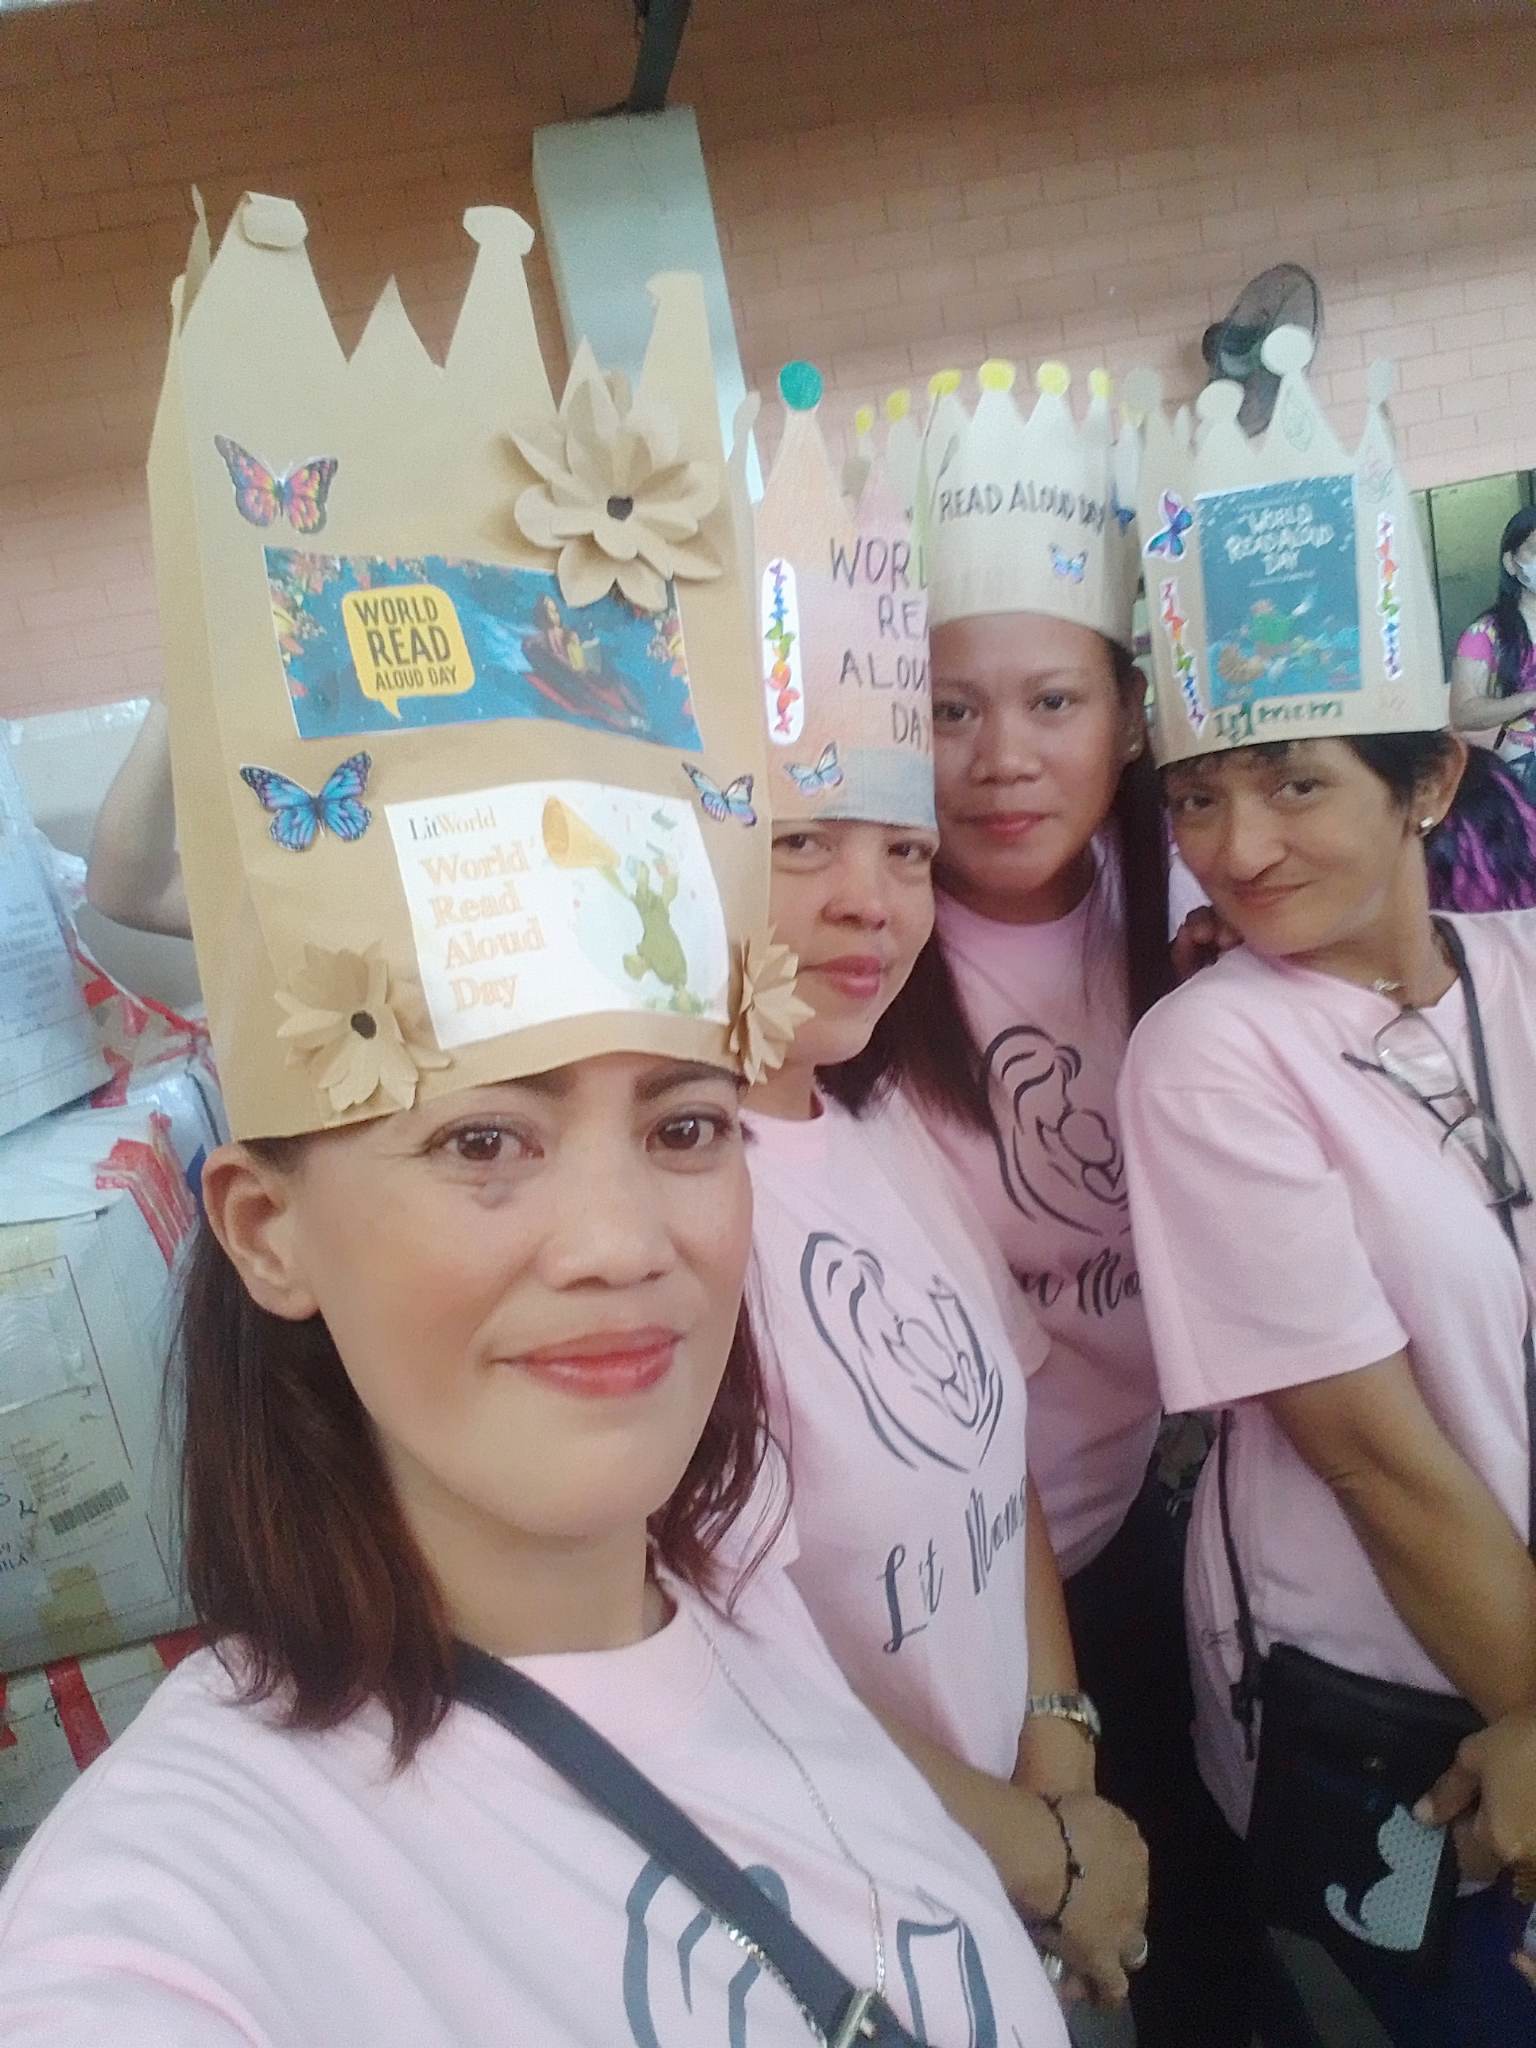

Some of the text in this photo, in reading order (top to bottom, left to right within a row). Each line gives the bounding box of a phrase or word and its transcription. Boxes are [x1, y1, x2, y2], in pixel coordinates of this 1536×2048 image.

[940, 482, 1003, 523] READ
[353, 595, 438, 626] WORLD
[367, 625, 451, 667] READ
[376, 665, 457, 691] ALOUD DAY
[409, 807, 496, 840] LitWorld
[419, 841, 530, 884] World
[431, 880, 522, 927] Read
[445, 914, 545, 969] Aloud
[450, 974, 518, 1012] Day
[876, 1538, 944, 1653] Lit
